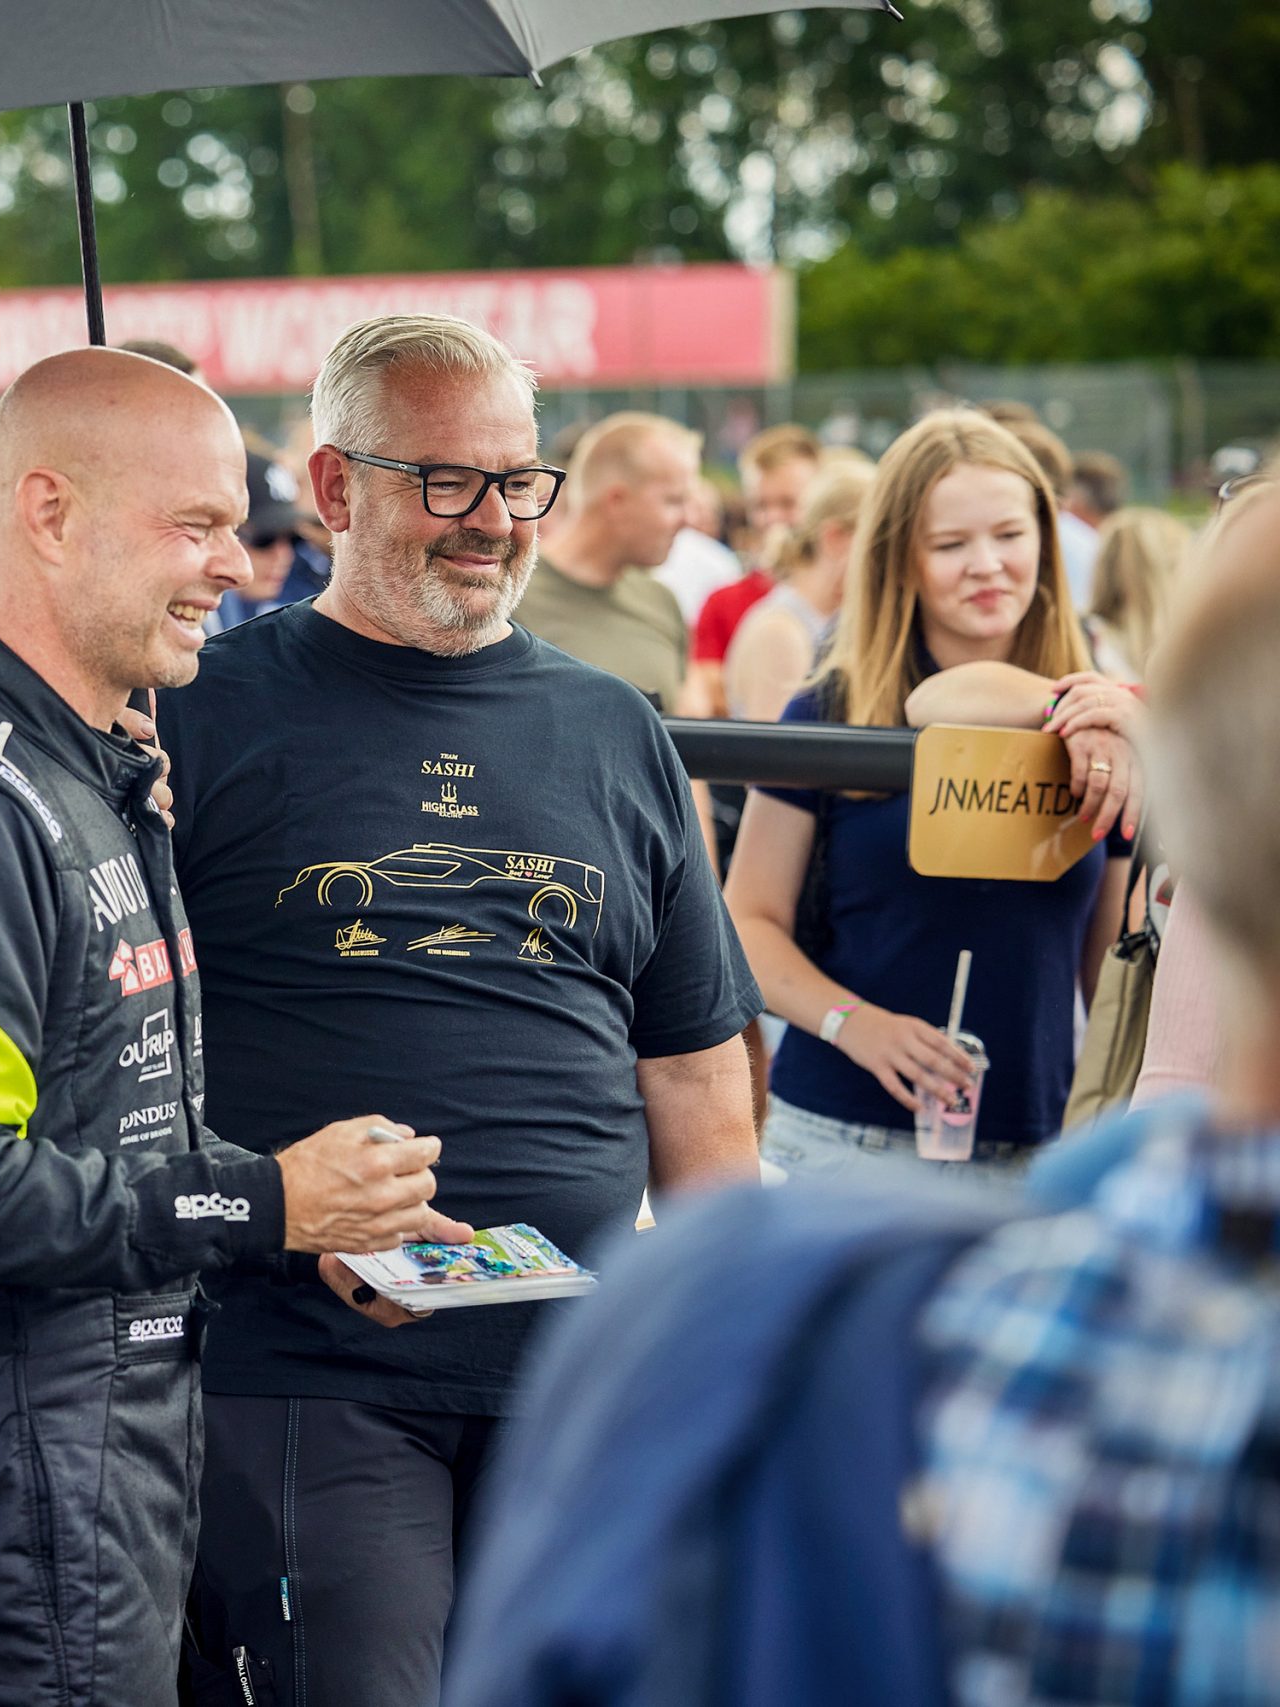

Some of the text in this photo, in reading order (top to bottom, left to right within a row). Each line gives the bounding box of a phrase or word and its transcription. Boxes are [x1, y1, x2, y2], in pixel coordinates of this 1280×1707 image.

[421, 760, 475, 778] SASHI
[422, 801, 479, 815] HIGH CLASS
[505, 855, 556, 874] SASHI
[174, 1192, 251, 1221] spco
[129, 1315, 184, 1342] sparco
[236, 1657, 254, 1706] KUMHO TYRE
